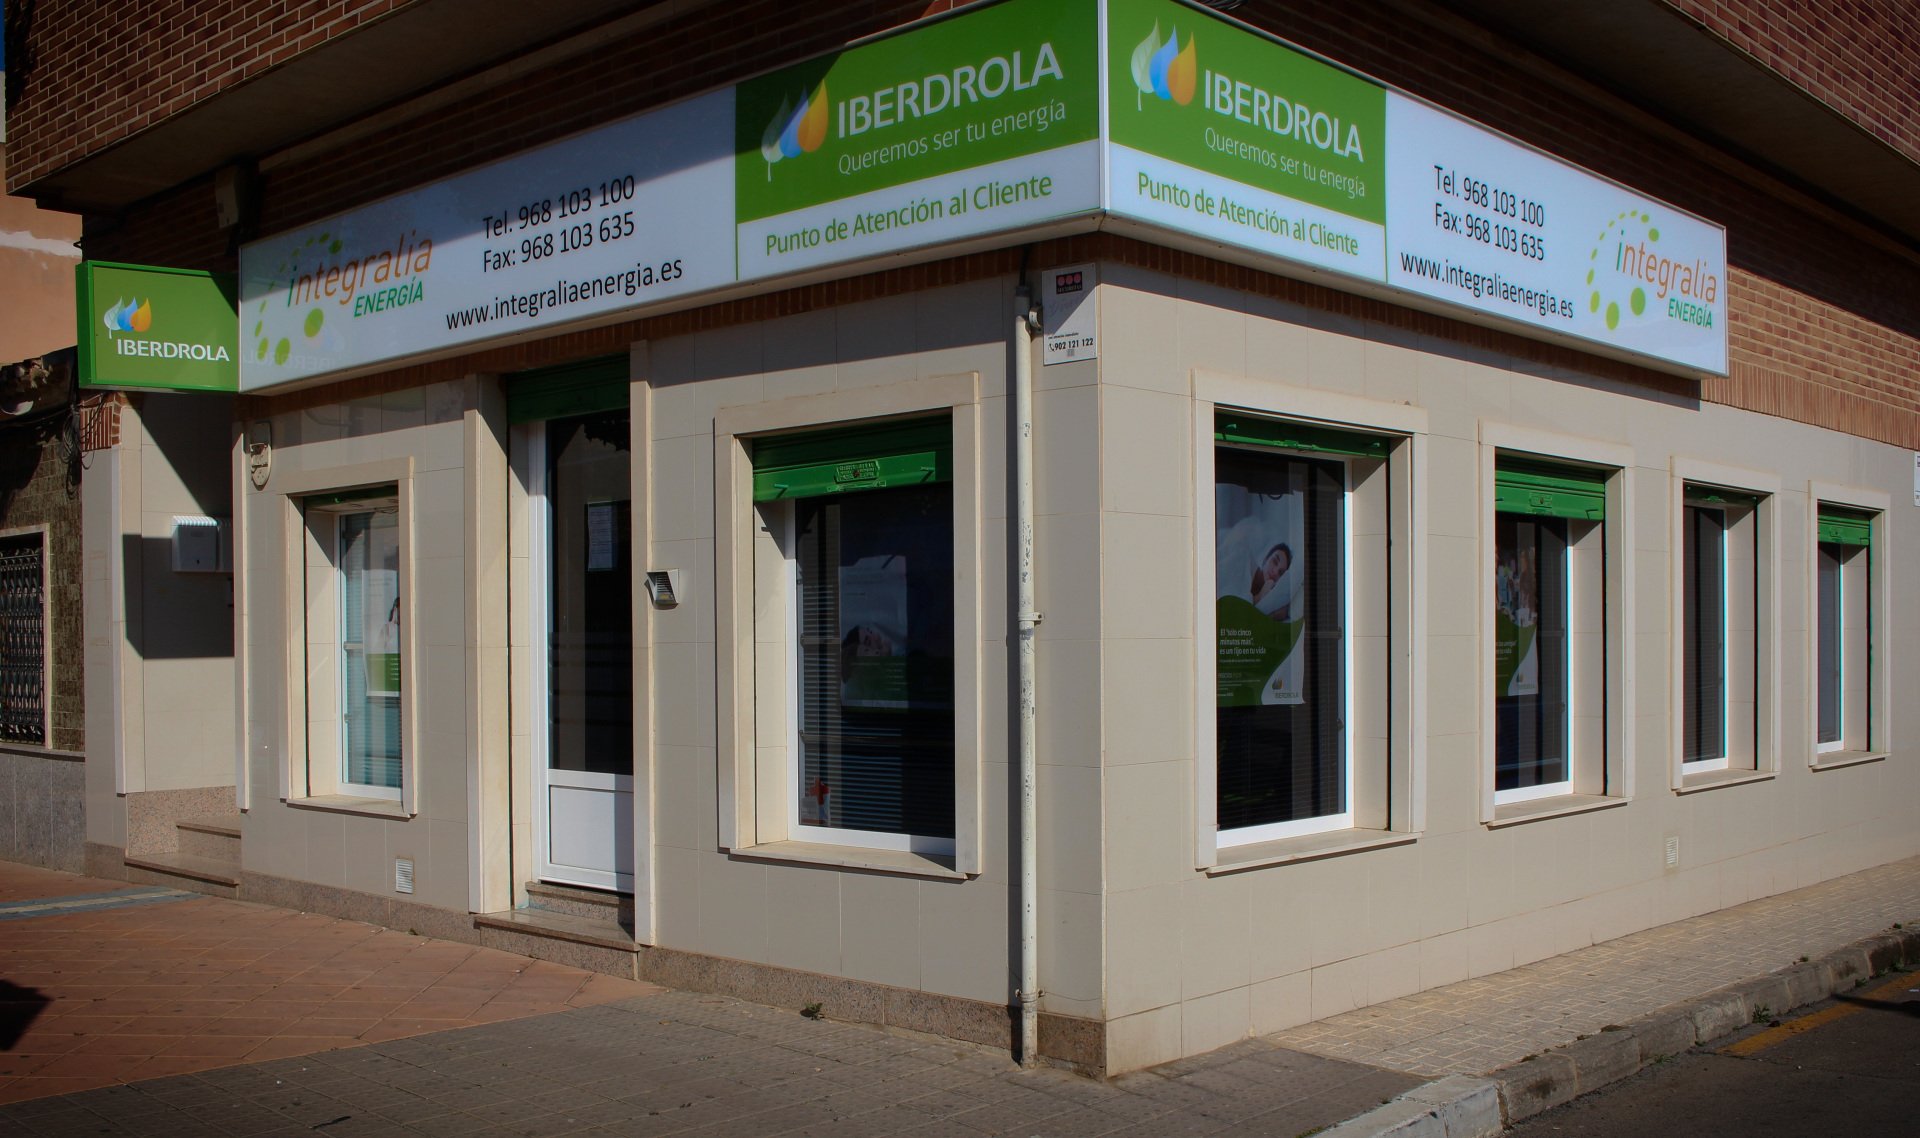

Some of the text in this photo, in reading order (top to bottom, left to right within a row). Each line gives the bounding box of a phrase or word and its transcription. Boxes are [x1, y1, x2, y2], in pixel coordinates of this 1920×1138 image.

[838, 42, 1064, 138] IBERDROLA
[1205, 69, 1364, 162] IBERDROLA
[839, 98, 1066, 175] Queremos ser tu energía
[1205, 127, 1365, 199] Queremos ser tu energía
[483, 175, 635, 239] Tel. 968 103 100
[766, 176, 1052, 256] Punto de Atención al Cliente
[1138, 171, 1359, 255] Punto de Atención al Cliente
[1434, 165, 1544, 227] Tel. 968 103 100
[484, 211, 635, 273] Fax: 968 103 635
[1435, 202, 1544, 261] Fax: 968 103 635
[1615, 229, 1717, 303] integralia
[287, 229, 434, 308] integralia
[354, 277, 423, 317] ENERGÍA
[446, 259, 683, 330] www.integraliaenergia.es
[1401, 252, 1574, 319] www.integraliaenergia.es
[1054, 338, 1094, 351] 902 121 122
[1668, 297, 1713, 329] ENERGÍA
[117, 339, 230, 362] IBERDROLA
